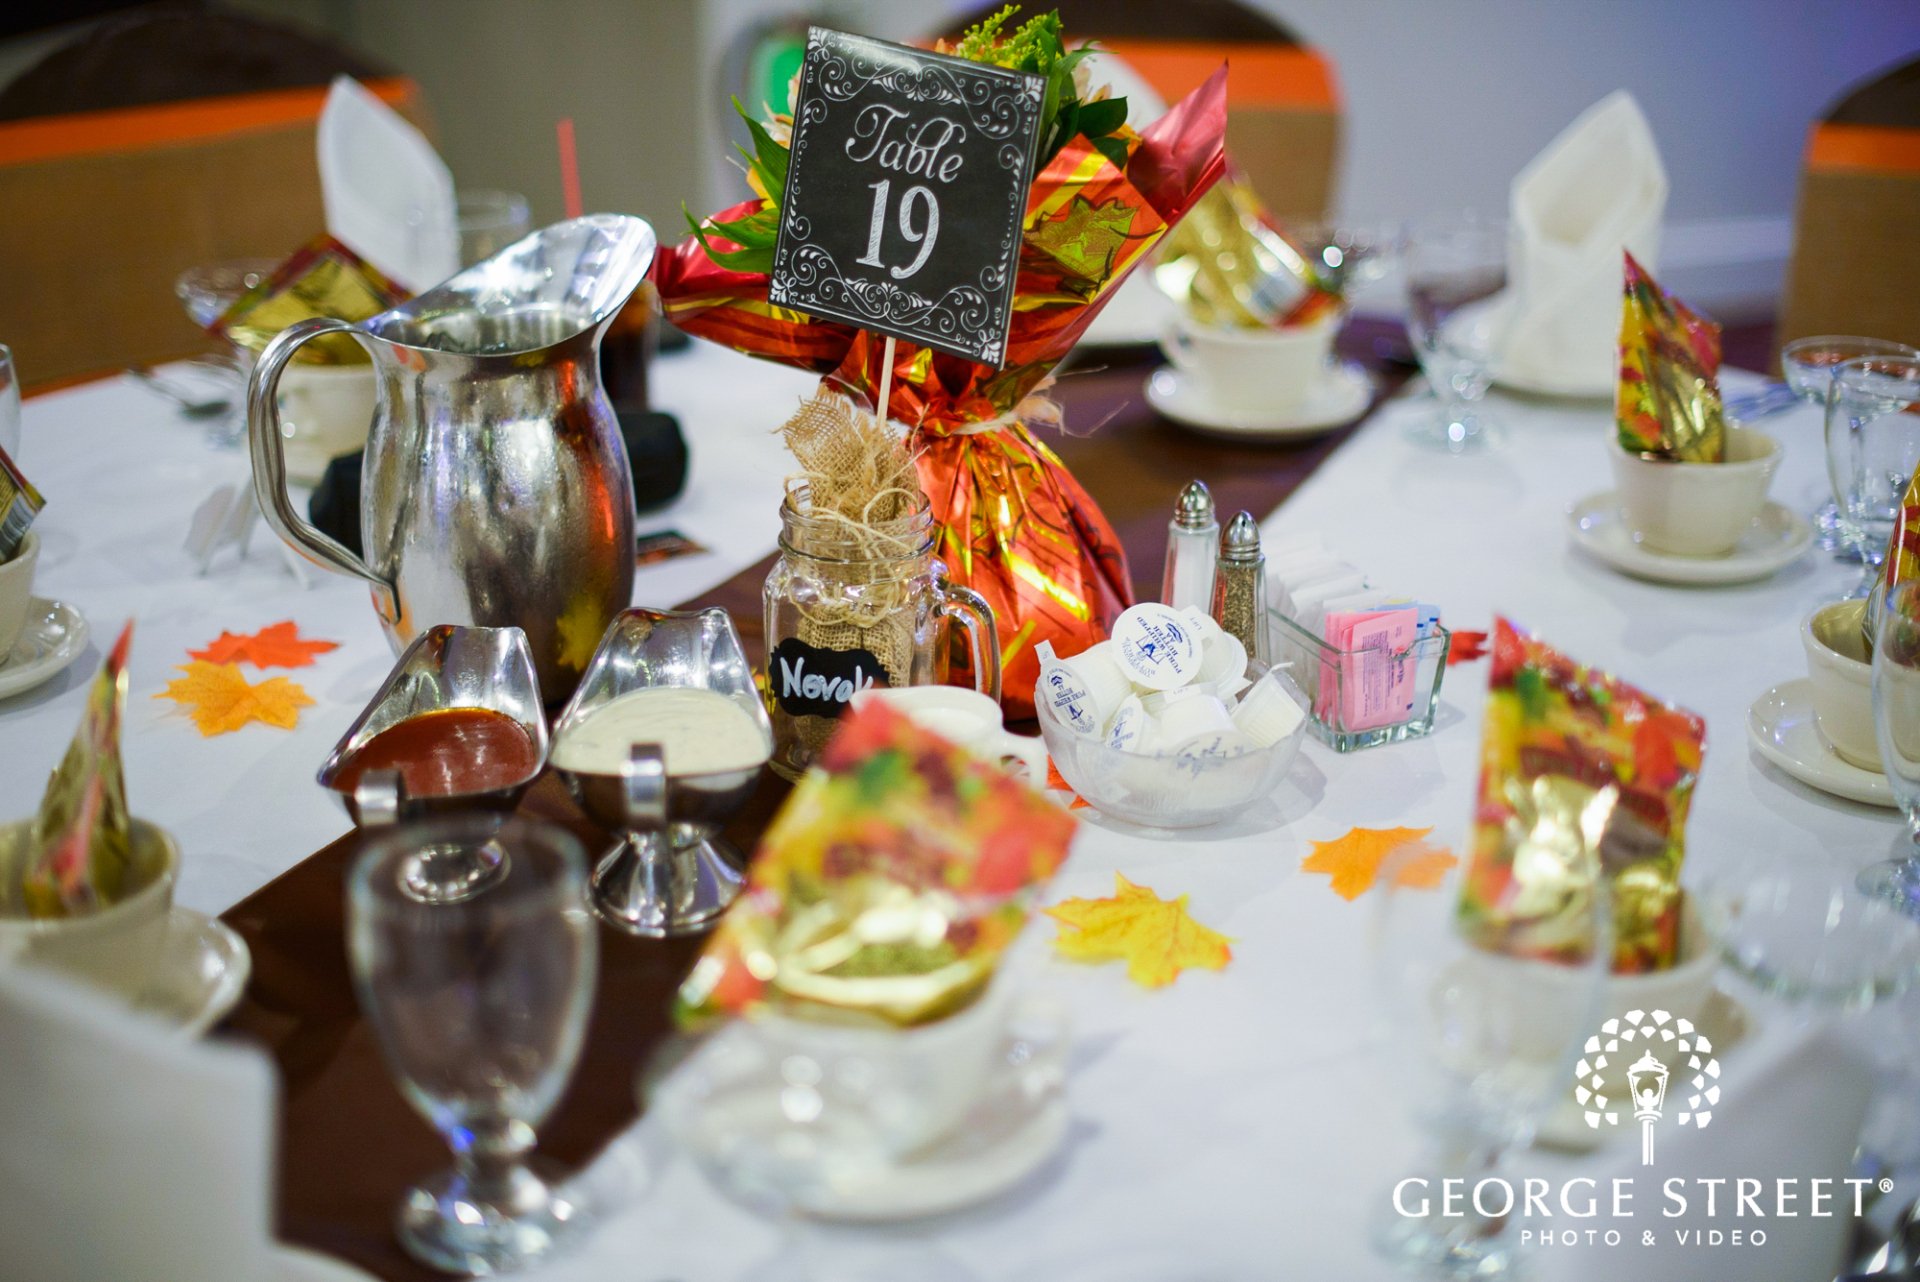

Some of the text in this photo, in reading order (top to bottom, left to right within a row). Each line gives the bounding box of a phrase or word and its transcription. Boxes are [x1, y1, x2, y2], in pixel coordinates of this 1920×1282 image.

[845, 103, 967, 184] Table
[856, 178, 941, 281] 19
[1136, 616, 1166, 651] WHIPPED
[1153, 625, 1179, 657] BUTTER
[1165, 651, 1182, 674] PURE
